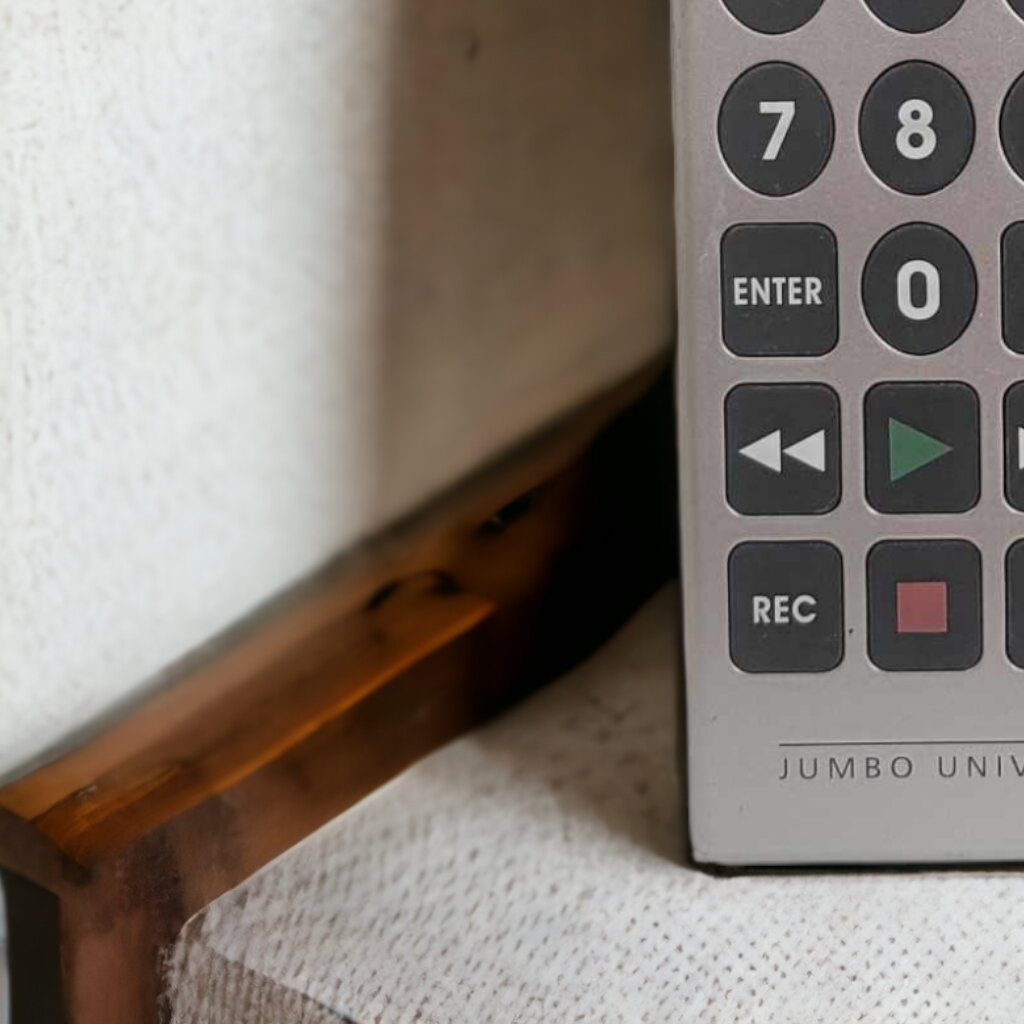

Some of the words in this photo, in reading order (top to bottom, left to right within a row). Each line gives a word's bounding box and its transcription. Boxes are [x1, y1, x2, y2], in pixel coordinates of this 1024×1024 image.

[760, 102, 794, 159] 7
[896, 100, 936, 159] 8
[734, 277, 821, 305] ENTER
[897, 260, 939, 320] 0
[754, 595, 815, 623] REC
[779, 757, 912, 780] JUMBO
